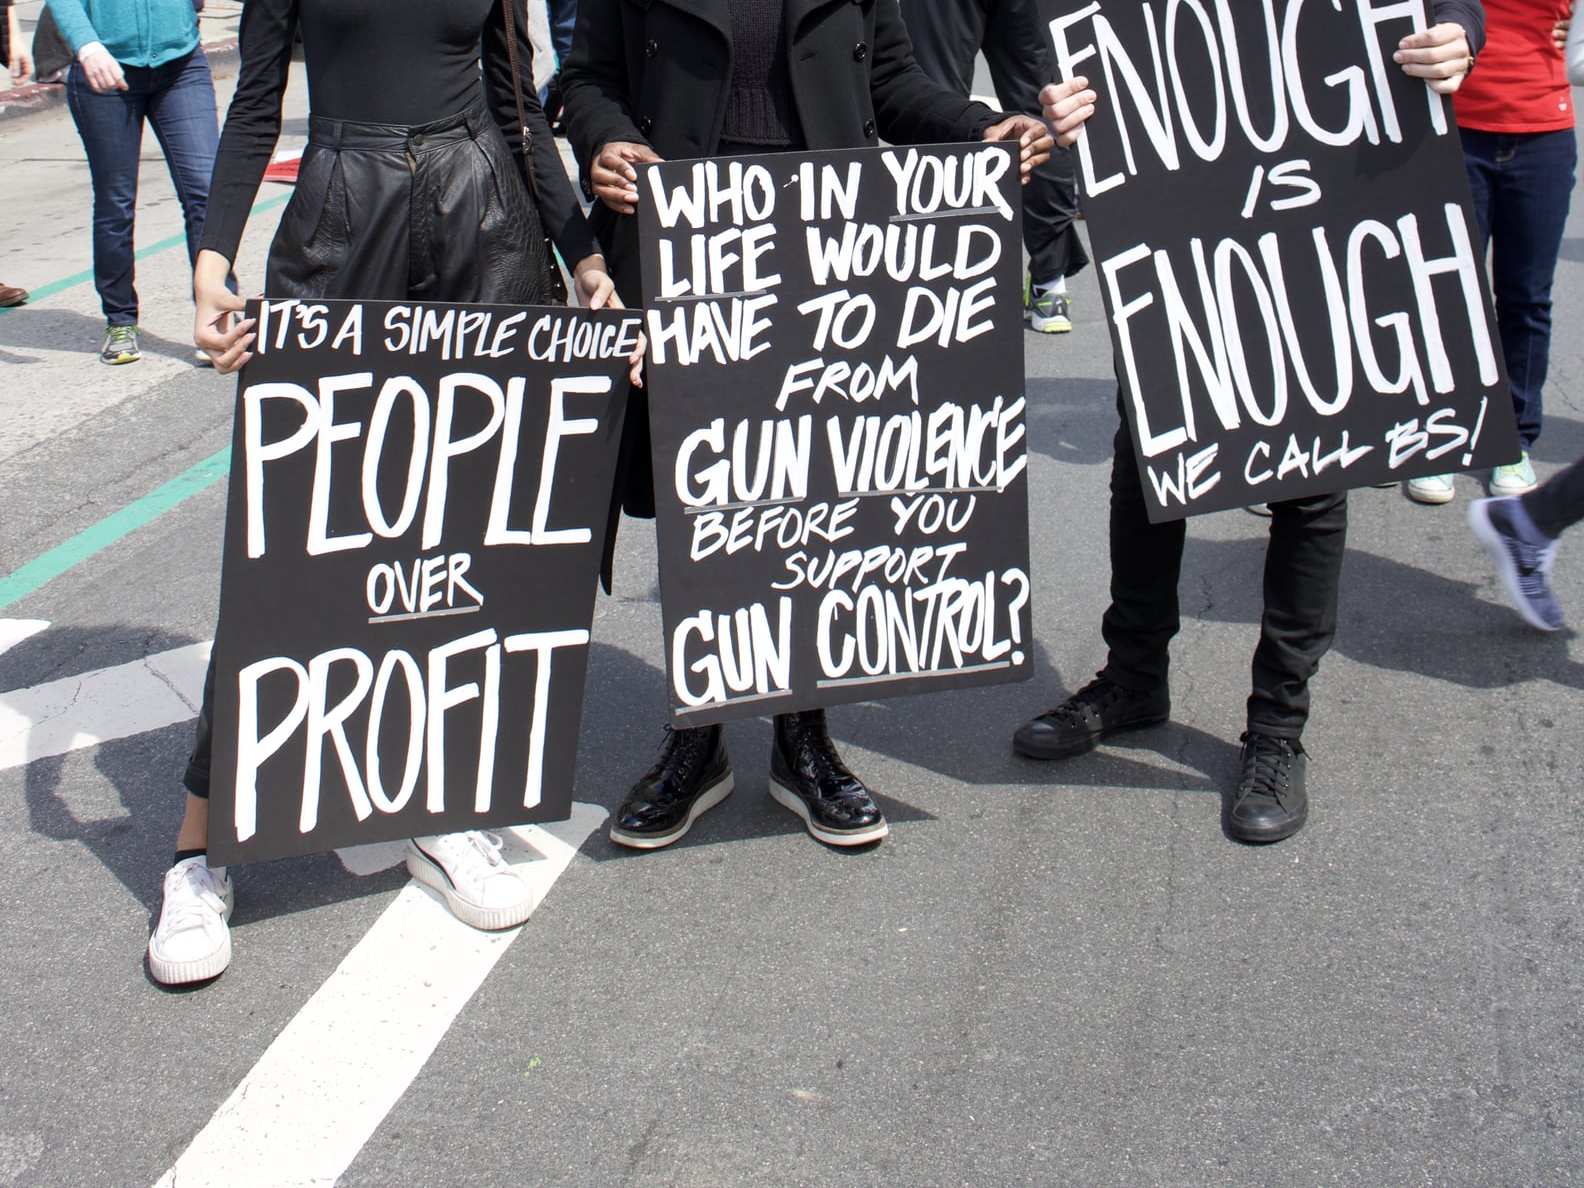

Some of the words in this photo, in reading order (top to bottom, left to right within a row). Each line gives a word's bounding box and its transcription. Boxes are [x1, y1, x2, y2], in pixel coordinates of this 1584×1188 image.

[647, 161, 776, 228] WHO
[799, 161, 862, 222] IN
[881, 146, 1013, 221] YOUR
[1241, 159, 1322, 219] IS
[658, 223, 782, 299] LIFE
[806, 222, 1002, 286] WOULD
[257, 299, 328, 354] IT'S
[332, 304, 363, 355] A
[384, 307, 527, 360] SIMPLE
[528, 313, 643, 363] CHOICE
[647, 293, 778, 365] HAVE
[797, 289, 877, 351] TO
[897, 277, 998, 349] DIE
[1101, 203, 1499, 458] ENOUGH
[775, 354, 919, 412] FROM
[243, 372, 612, 559] PEOPLE
[674, 414, 812, 507] GUN
[826, 395, 1028, 495] VIOLENCE
[1147, 442, 1221, 507] WE
[1244, 429, 1375, 486] CALL
[1385, 395, 1488, 470] BS!
[690, 497, 860, 562] BEFORE
[890, 494, 976, 536] YOU
[771, 542, 967, 592] SUPPORT
[366, 552, 485, 614] OVER
[672, 596, 792, 707] GUN
[816, 567, 1031, 679] CONTROL?
[234, 627, 590, 843] PROFIT
